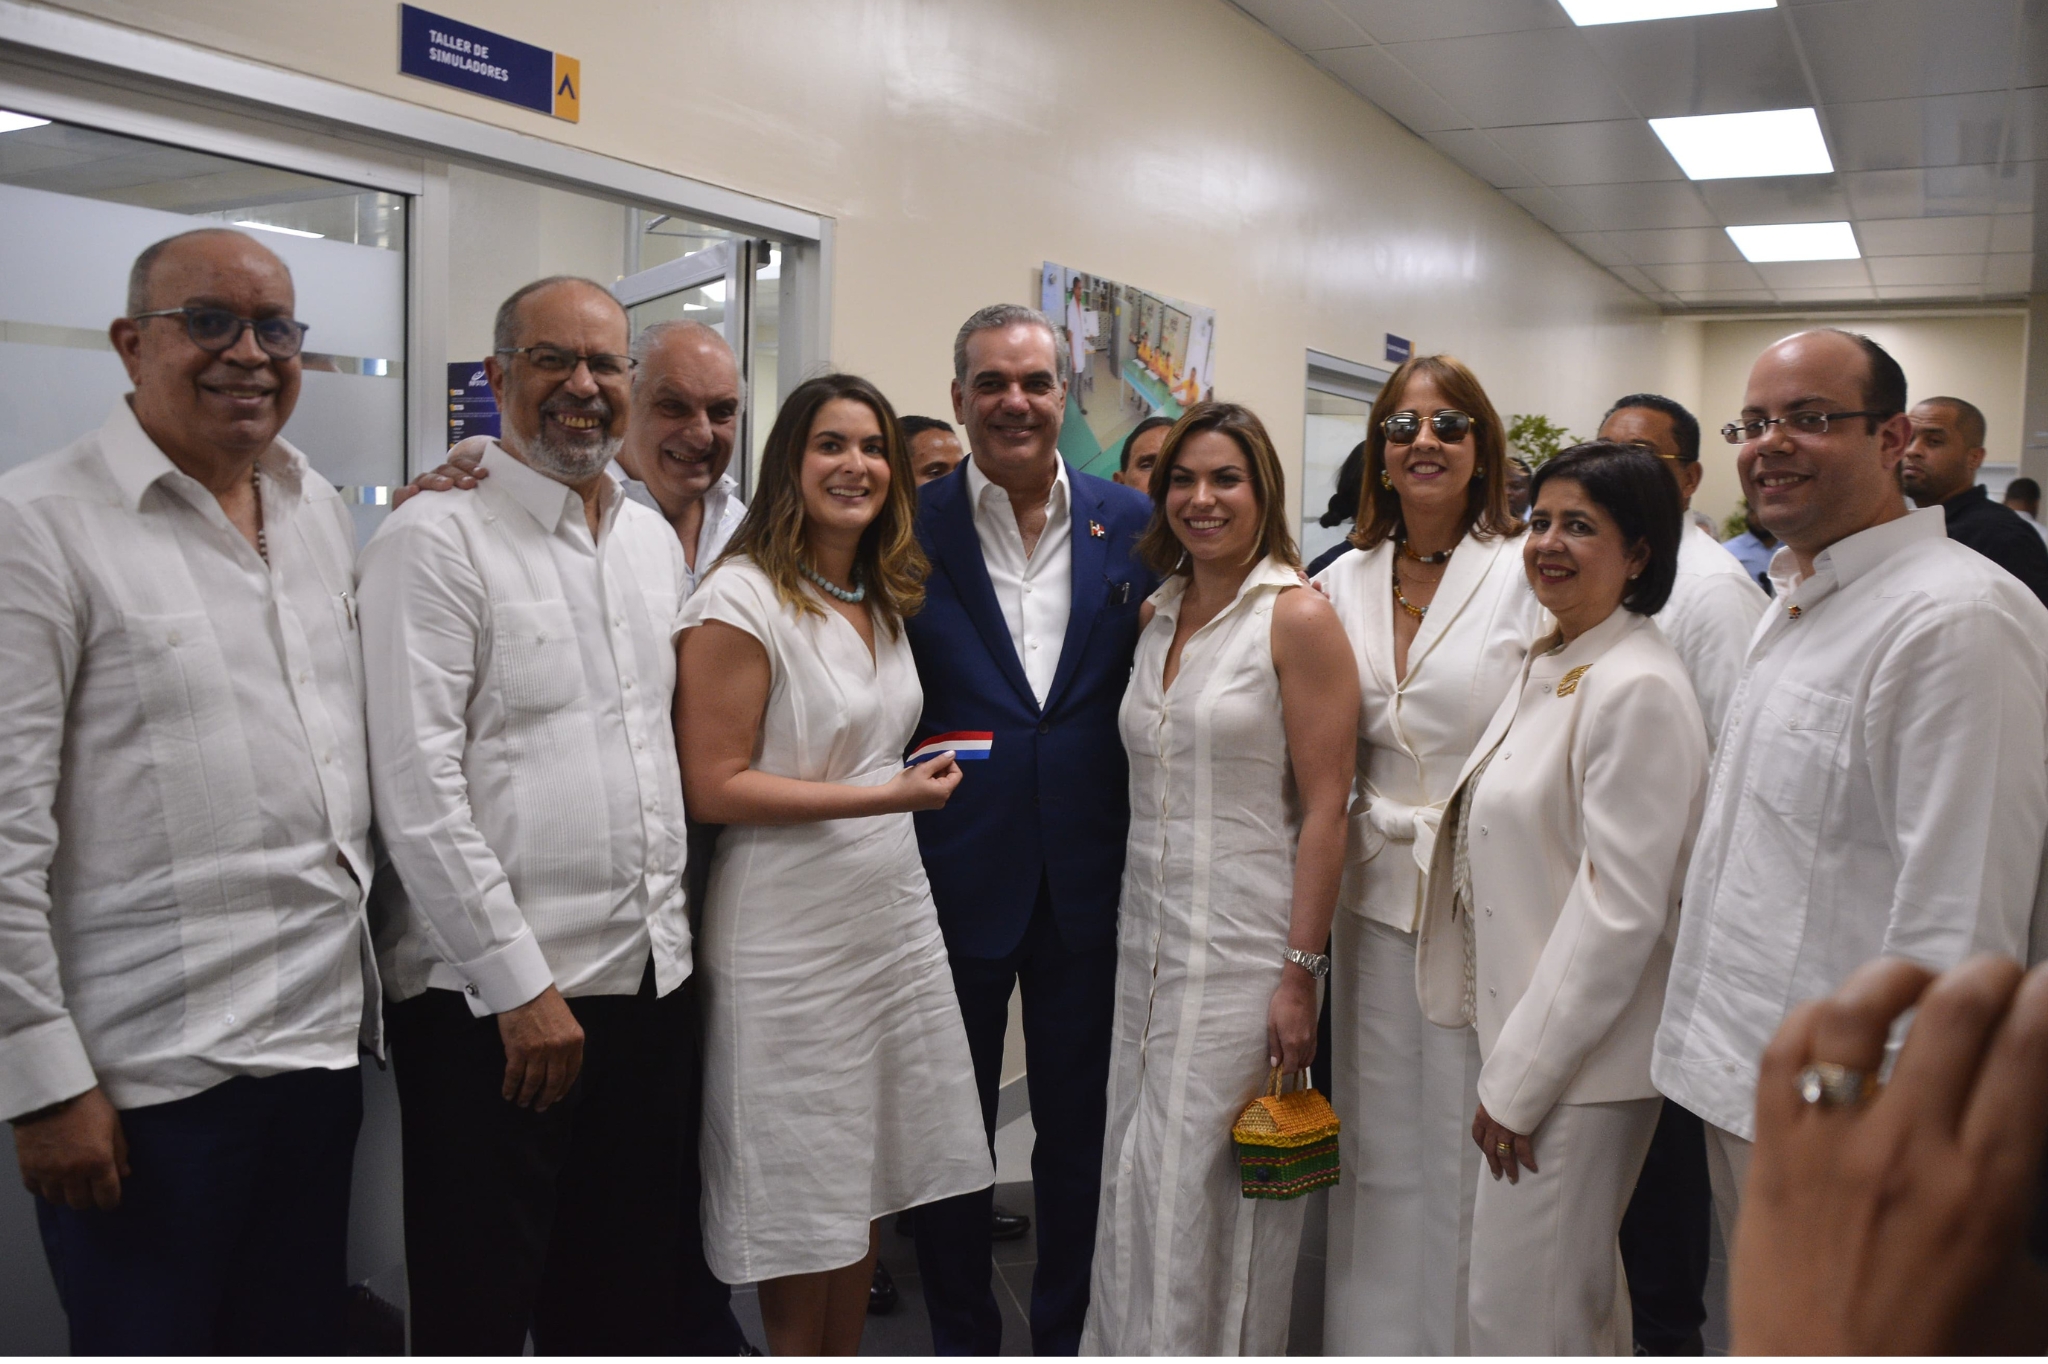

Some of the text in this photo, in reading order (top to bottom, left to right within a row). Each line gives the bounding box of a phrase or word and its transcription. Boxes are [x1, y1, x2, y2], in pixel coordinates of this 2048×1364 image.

[429, 29, 489, 59] TALLER DE
[429, 47, 509, 82] SIMULADORES
